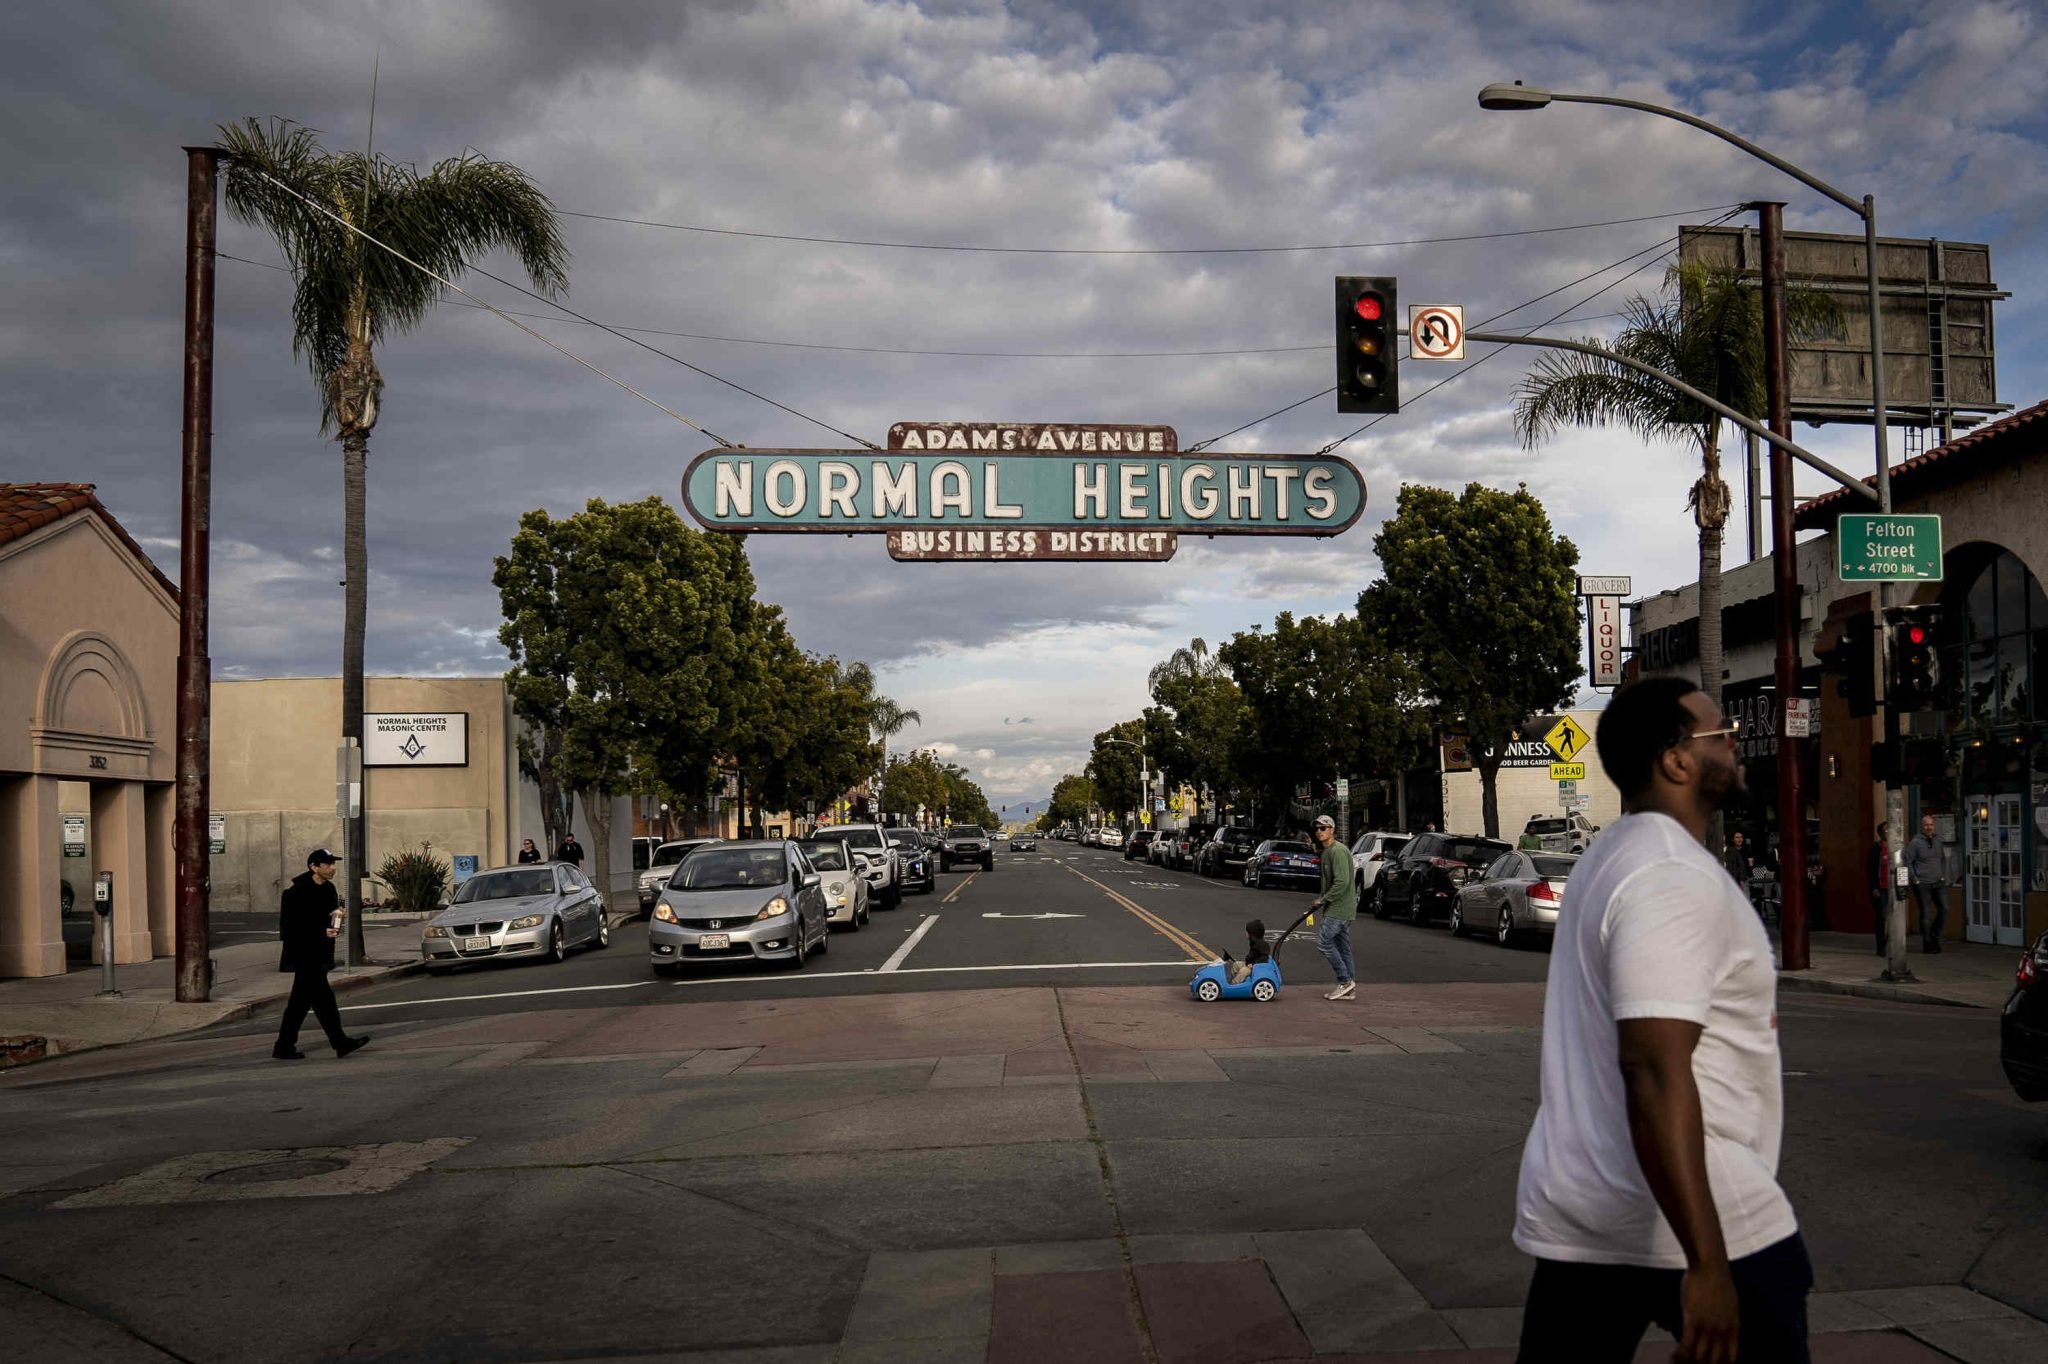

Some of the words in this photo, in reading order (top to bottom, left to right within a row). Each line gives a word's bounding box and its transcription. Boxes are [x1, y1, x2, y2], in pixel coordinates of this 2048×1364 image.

[902, 429, 1017, 450] ADAMS
[1036, 430, 1164, 451] AVENUE
[715, 459, 1023, 519] NORMAL
[1073, 462, 1338, 521] HEIGHTS
[1866, 521, 1915, 537] Felton
[901, 531, 1037, 552] BUSINESS
[1051, 531, 1167, 552] DISTRICT
[1866, 542, 1915, 558] Street
[1868, 562, 1898, 574] 4700
[1901, 563, 1915, 574] blk
[1583, 579, 1628, 592] GROCERY
[1600, 598, 1614, 675] LIQUOR
[412, 717, 447, 725] HEIGHTS
[416, 724, 446, 732] CENTER
[1553, 766, 1581, 776] AHEAD
